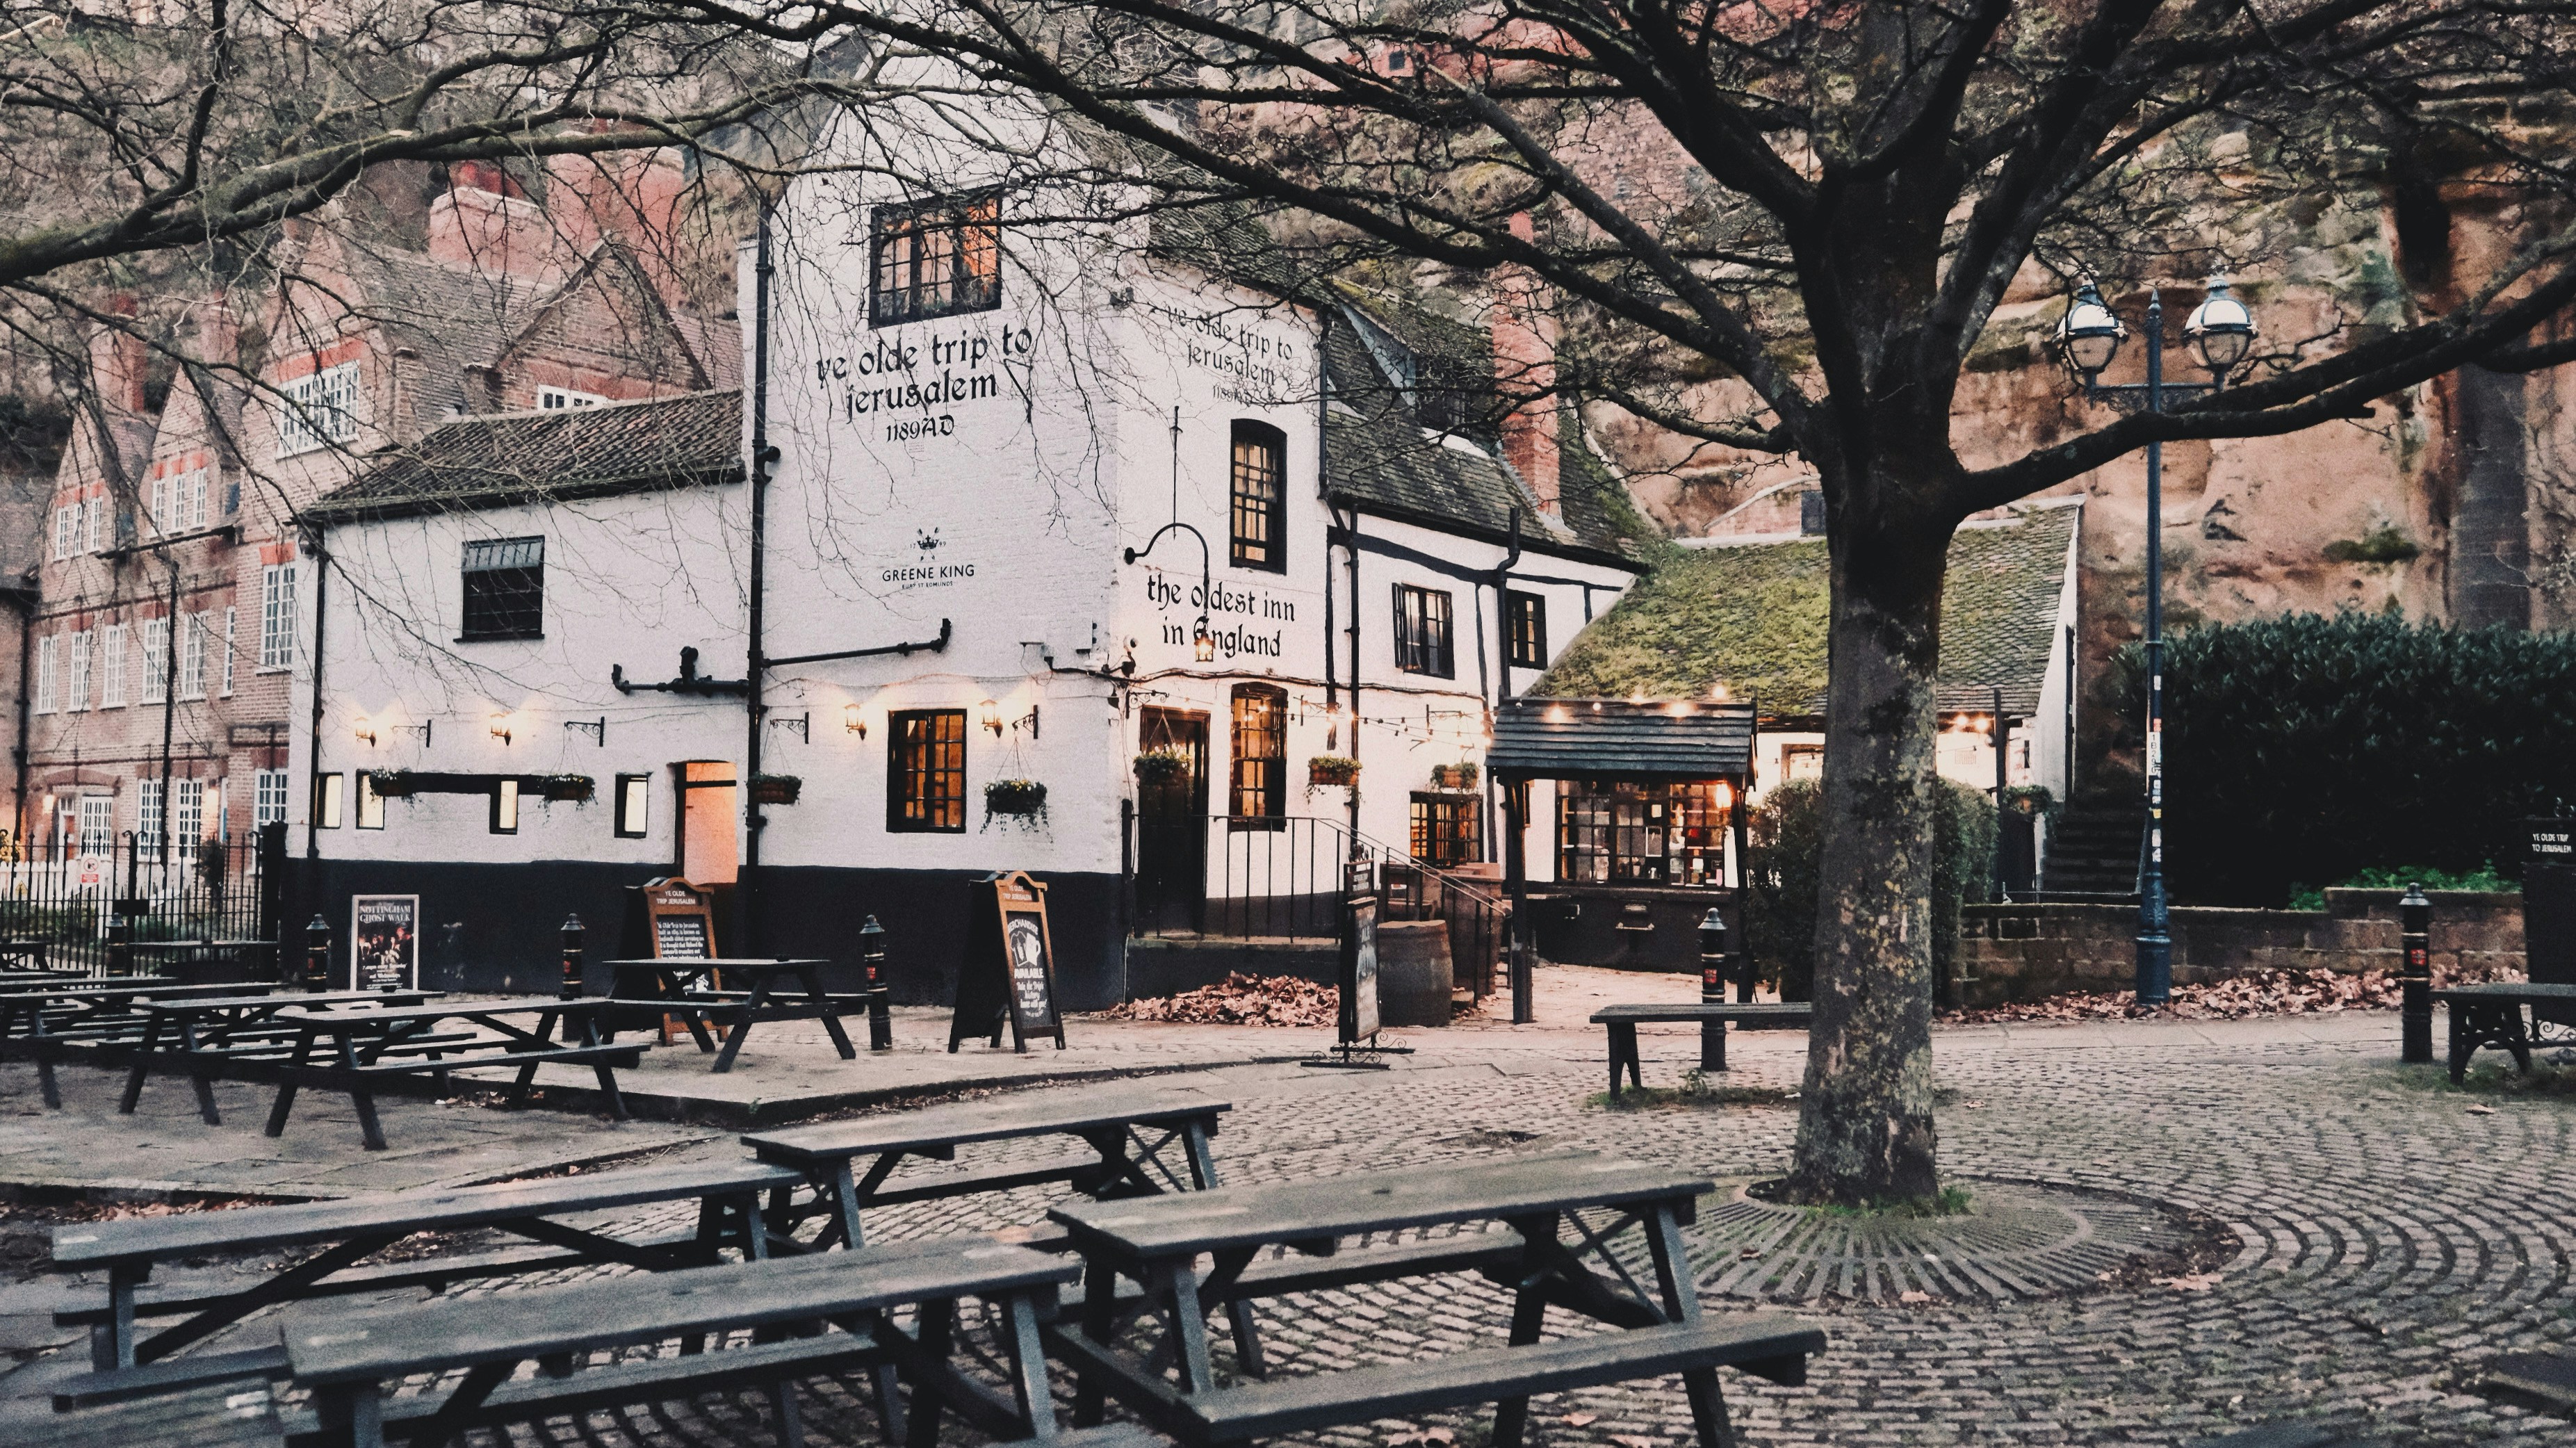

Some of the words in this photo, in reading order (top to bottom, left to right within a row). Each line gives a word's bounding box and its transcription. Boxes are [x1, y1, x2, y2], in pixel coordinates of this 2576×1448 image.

[1196, 315, 1231, 339] olde
[1240, 323, 1270, 358] trip
[1278, 336, 1292, 360] to
[816, 355, 847, 389] ye
[859, 337, 918, 375] olde
[932, 330, 988, 369] trip
[1002, 323, 1032, 356] to
[1187, 338, 1275, 386] jerusalem
[846, 368, 997, 424] jerusalem
[886, 414, 955, 443] 1189AD
[882, 567, 934, 582] GREENE
[940, 564, 975, 578] KING
[1148, 573, 1182, 610] the
[1191, 578, 1256, 615] oldest
[1264, 591, 1295, 622] inn
[1163, 615, 1184, 646] in
[1193, 616, 1281, 659] England
[2532, 833, 2540, 841] YE
[2541, 833, 2556, 842] OLDE
[2532, 843, 2541, 852] TO
[2541, 844, 2572, 853] JERUSALEM
[359, 905, 411, 914] NOTTINGHAM
[359, 914, 385, 924] GHOST
[1014, 968, 1044, 979] AVAILABLE
